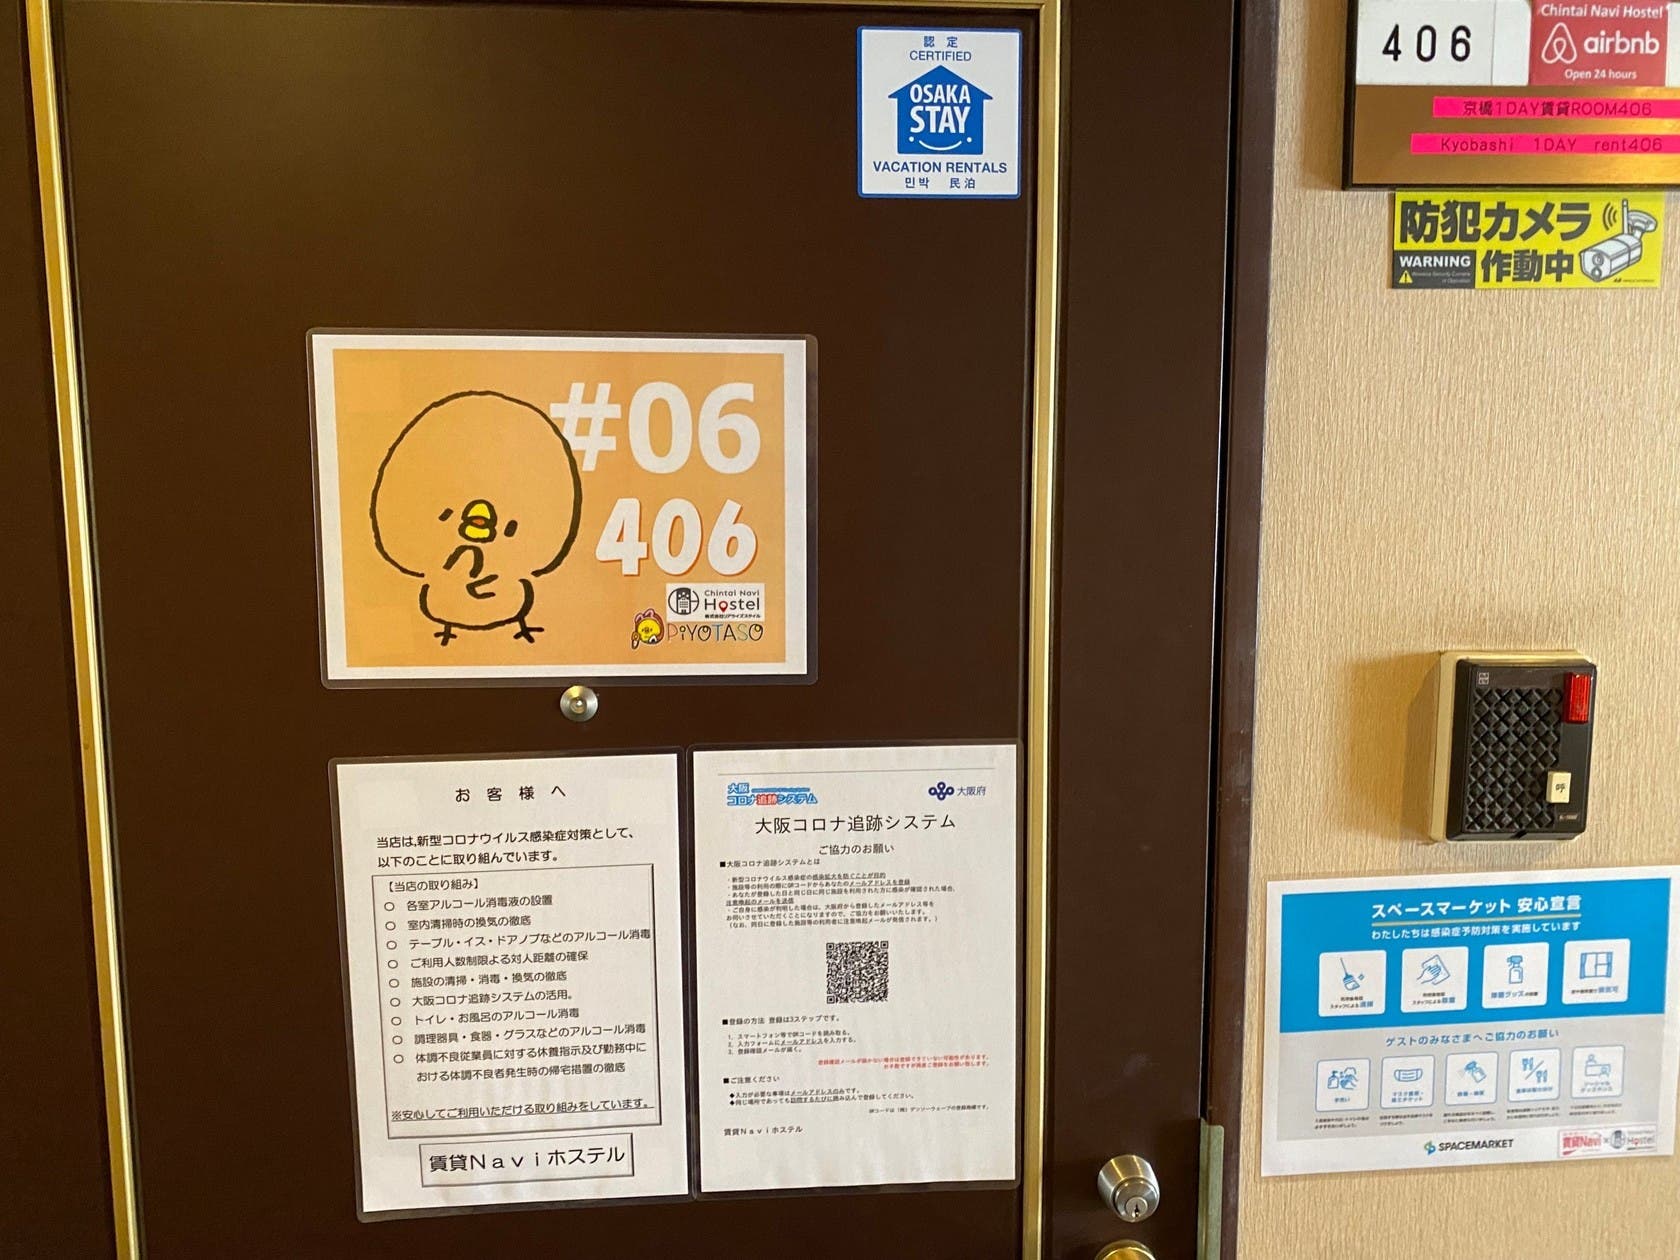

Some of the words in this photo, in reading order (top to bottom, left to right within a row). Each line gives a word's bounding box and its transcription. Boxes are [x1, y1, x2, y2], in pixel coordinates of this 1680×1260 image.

[1541, 4, 1587, 17] Chintai
[1591, 5, 1620, 17] Navi
[1623, 6, 1663, 18] Hostel
[1383, 24, 1471, 62] 406
[1584, 30, 1660, 55] airbnb
[910, 51, 972, 61] CERTIFIED
[1565, 69, 1592, 80] Open
[1594, 69, 1607, 78] 24
[1609, 69, 1637, 79] hours
[910, 84, 971, 104] OSAKA
[910, 105, 971, 134] STAY
[1441, 137, 1514, 153] Kyobashi
[1534, 137, 1577, 151] 1DAY
[1594, 136, 1663, 151] rent406
[873, 161, 941, 173] VACATION
[946, 161, 1007, 174] RENTALS
[905, 178, 931, 189] 민박
[950, 178, 976, 189] 民泊
[1400, 200, 1592, 244] 防犯カメラ
[1399, 255, 1471, 268] WARNING
[1481, 249, 1574, 283] 作動中
[550, 382, 761, 475] #06
[595, 498, 759, 577] 406
[705, 589, 737, 597] Chintai
[705, 598, 760, 612] Hostel
[728, 783, 749, 794] 大阪
[956, 785, 987, 797] 大阪府
[727, 793, 818, 806] コロナ追跡システム
[755, 813, 956, 835] 大阪コロナ追跡システム
[819, 843, 896, 856] ご協力のお願い
[378, 850, 559, 868] 以下のことに取り組んでいます。
[388, 878, 480, 893] 【当店の取り組み】
[1371, 898, 1512, 918] スペースマーケット
[1517, 894, 1582, 913] 安心宣言
[1371, 921, 1581, 940] わたしたちは感染症予防対策を実施しています
[412, 989, 573, 1008] 大阪コロナ追跡システムの活用。
[1386, 1028, 1560, 1047] ゲストのみなさまへご協力のお願い
[1438, 1138, 1514, 1153] SPACEMARKET
